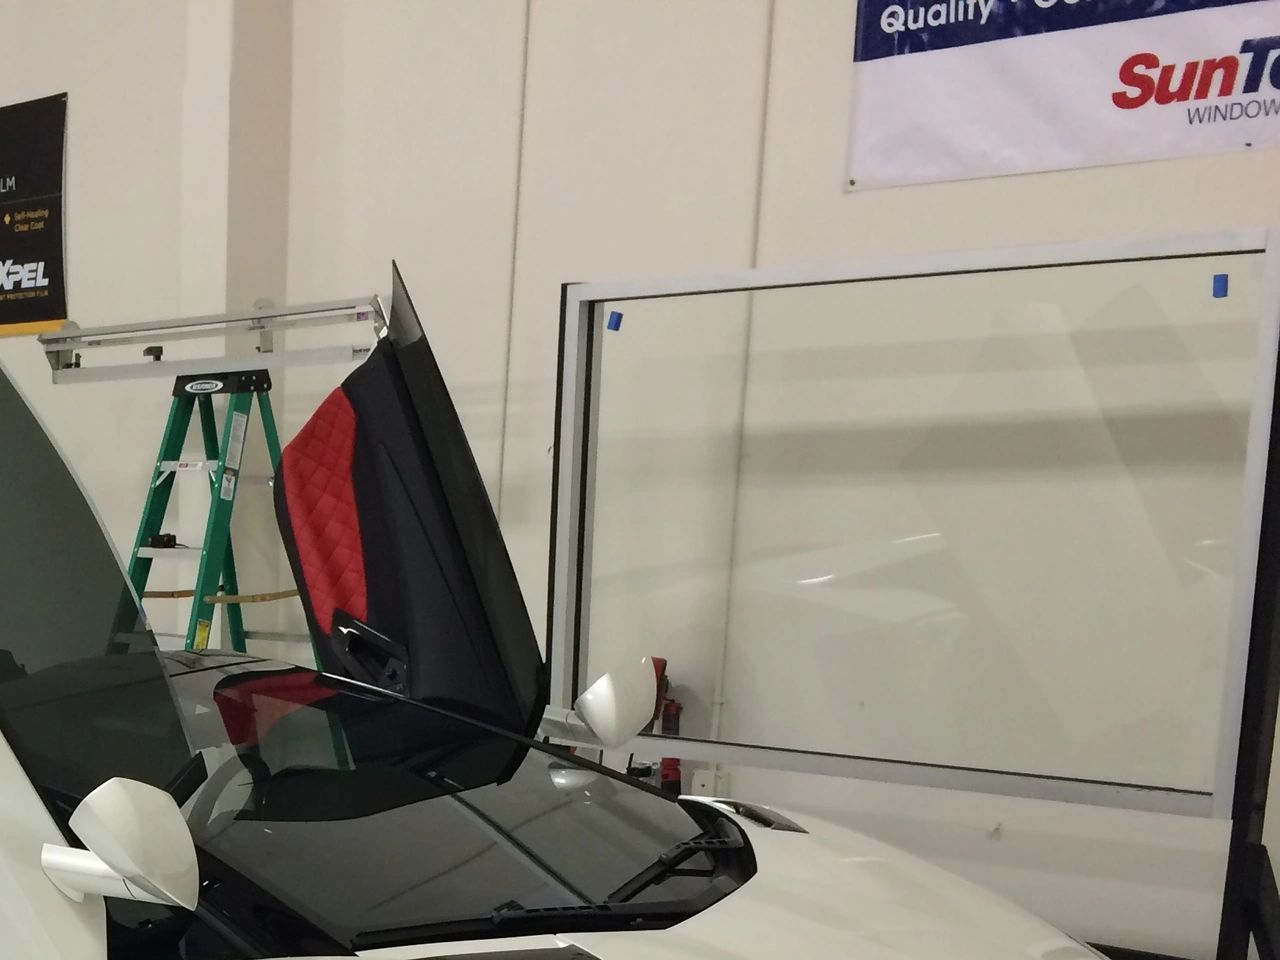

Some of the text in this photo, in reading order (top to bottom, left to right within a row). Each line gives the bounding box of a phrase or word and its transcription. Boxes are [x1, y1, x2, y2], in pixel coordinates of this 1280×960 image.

[880, 0, 995, 33] Quality
[1111, 35, 1280, 109] SunT
[1187, 98, 1280, 125] WINDOW
